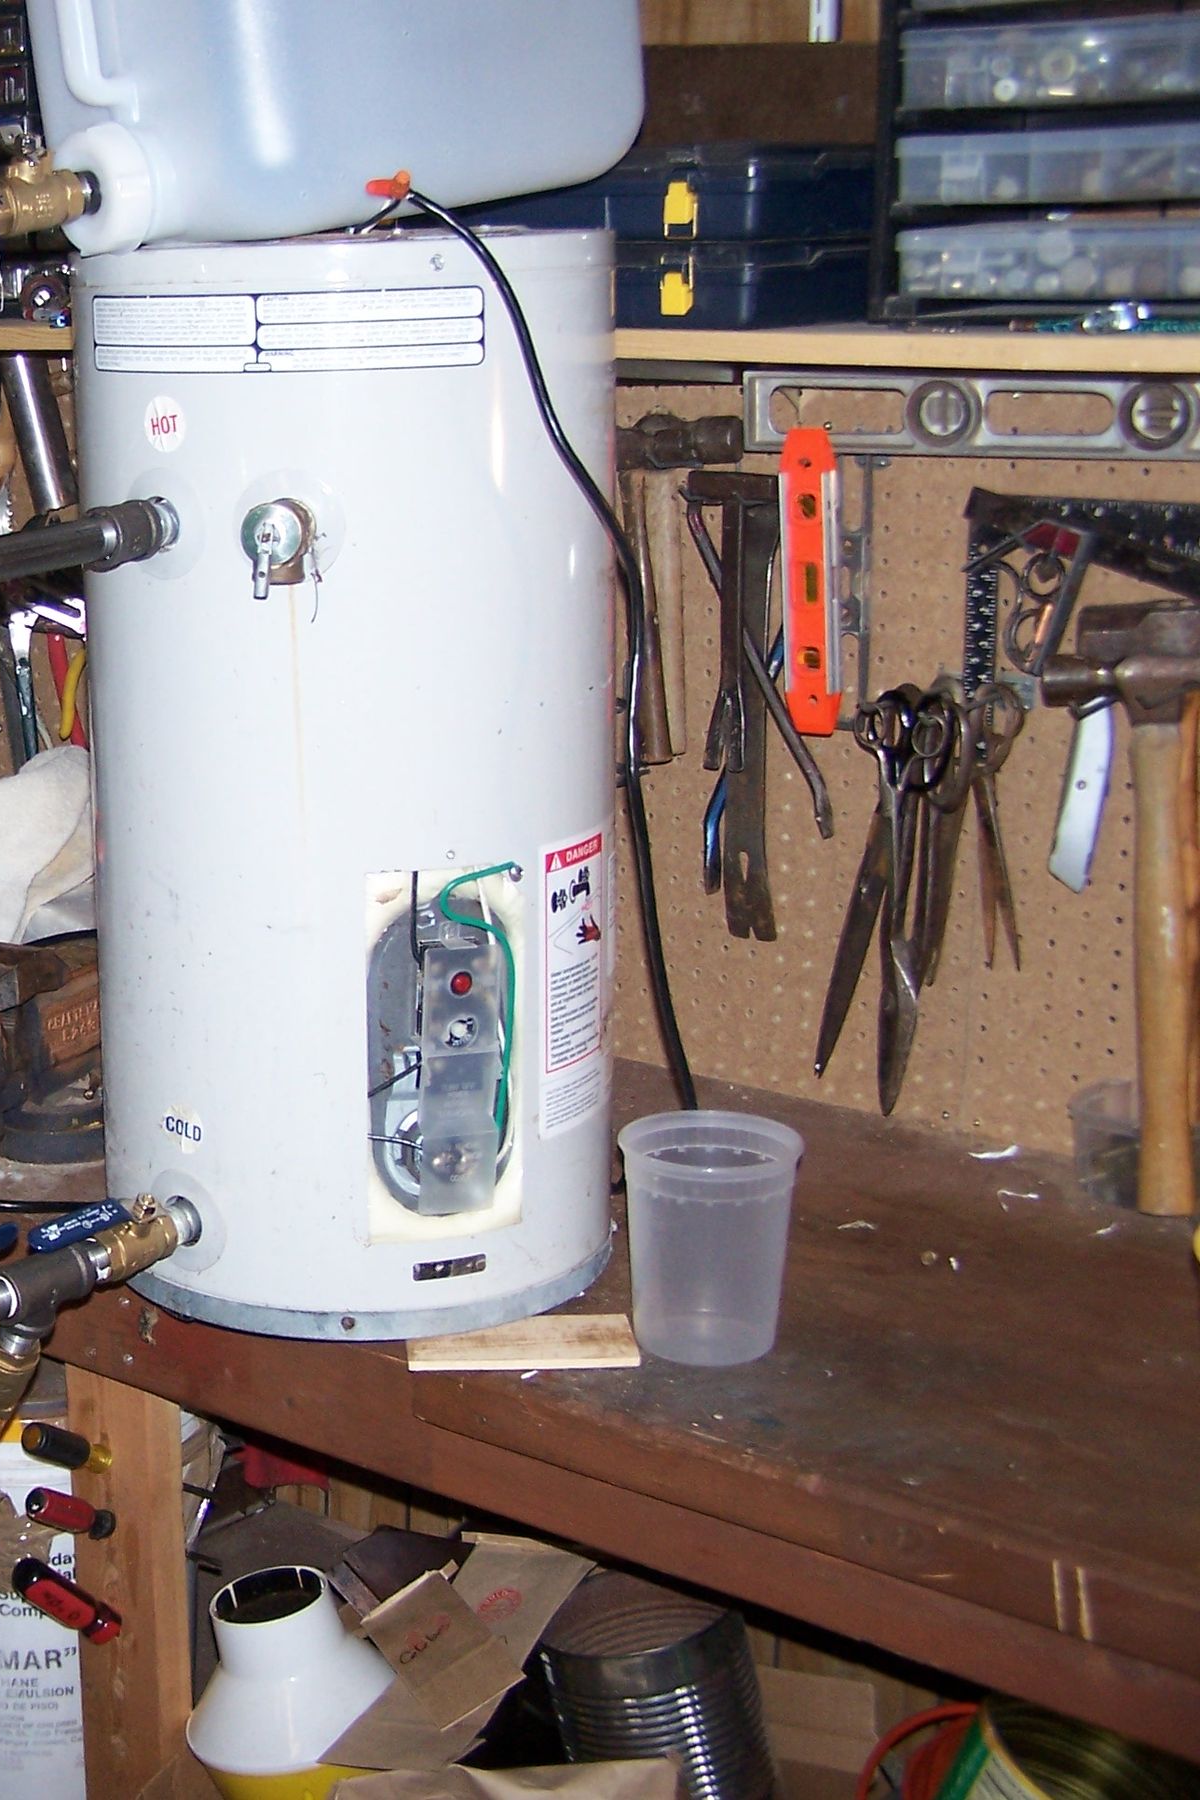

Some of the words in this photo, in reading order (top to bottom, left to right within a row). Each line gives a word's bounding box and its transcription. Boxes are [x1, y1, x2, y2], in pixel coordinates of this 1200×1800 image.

[150, 414, 178, 436] HOT
[565, 839, 599, 863] DANGER
[165, 1116, 202, 1142] COLD
